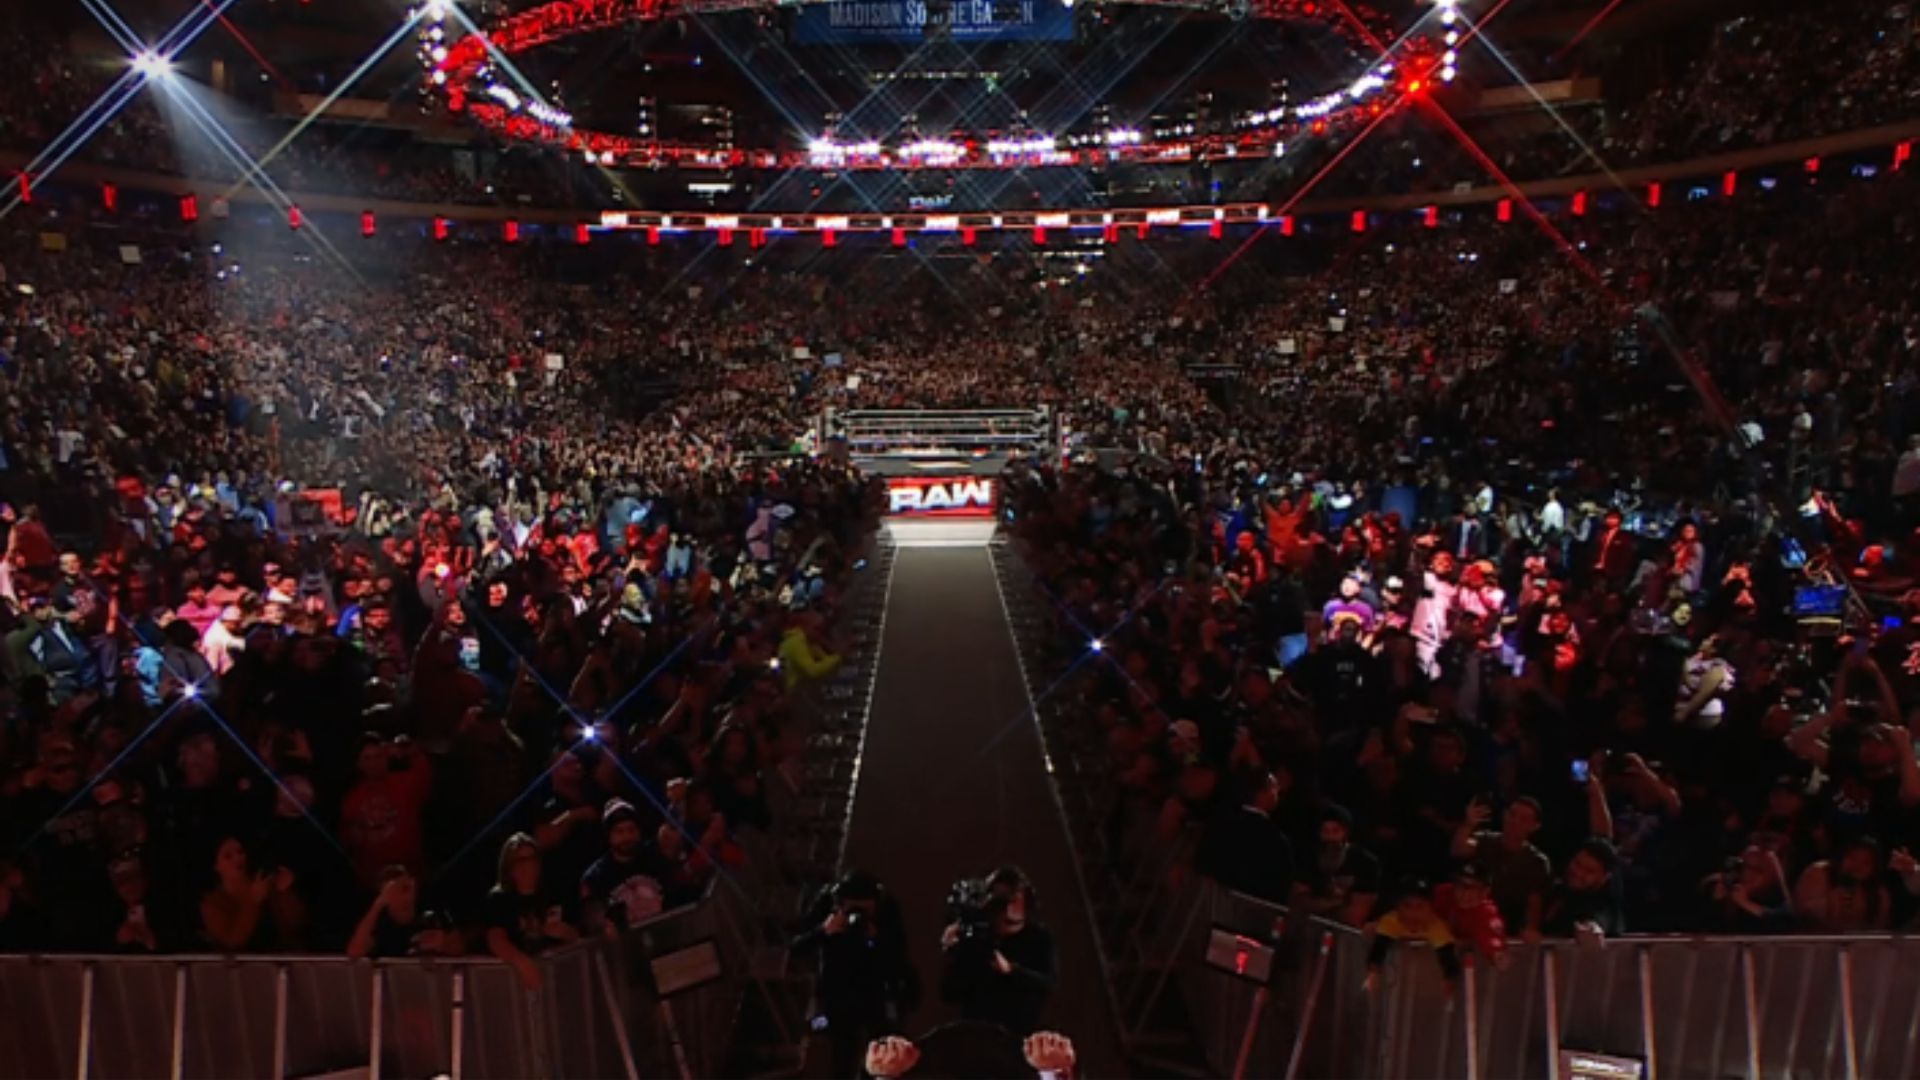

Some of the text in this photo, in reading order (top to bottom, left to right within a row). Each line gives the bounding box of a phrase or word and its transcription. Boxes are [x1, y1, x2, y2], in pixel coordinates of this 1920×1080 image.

[830, 0, 1033, 26] MADISON SQRE GAN
[889, 480, 991, 513] RAW
